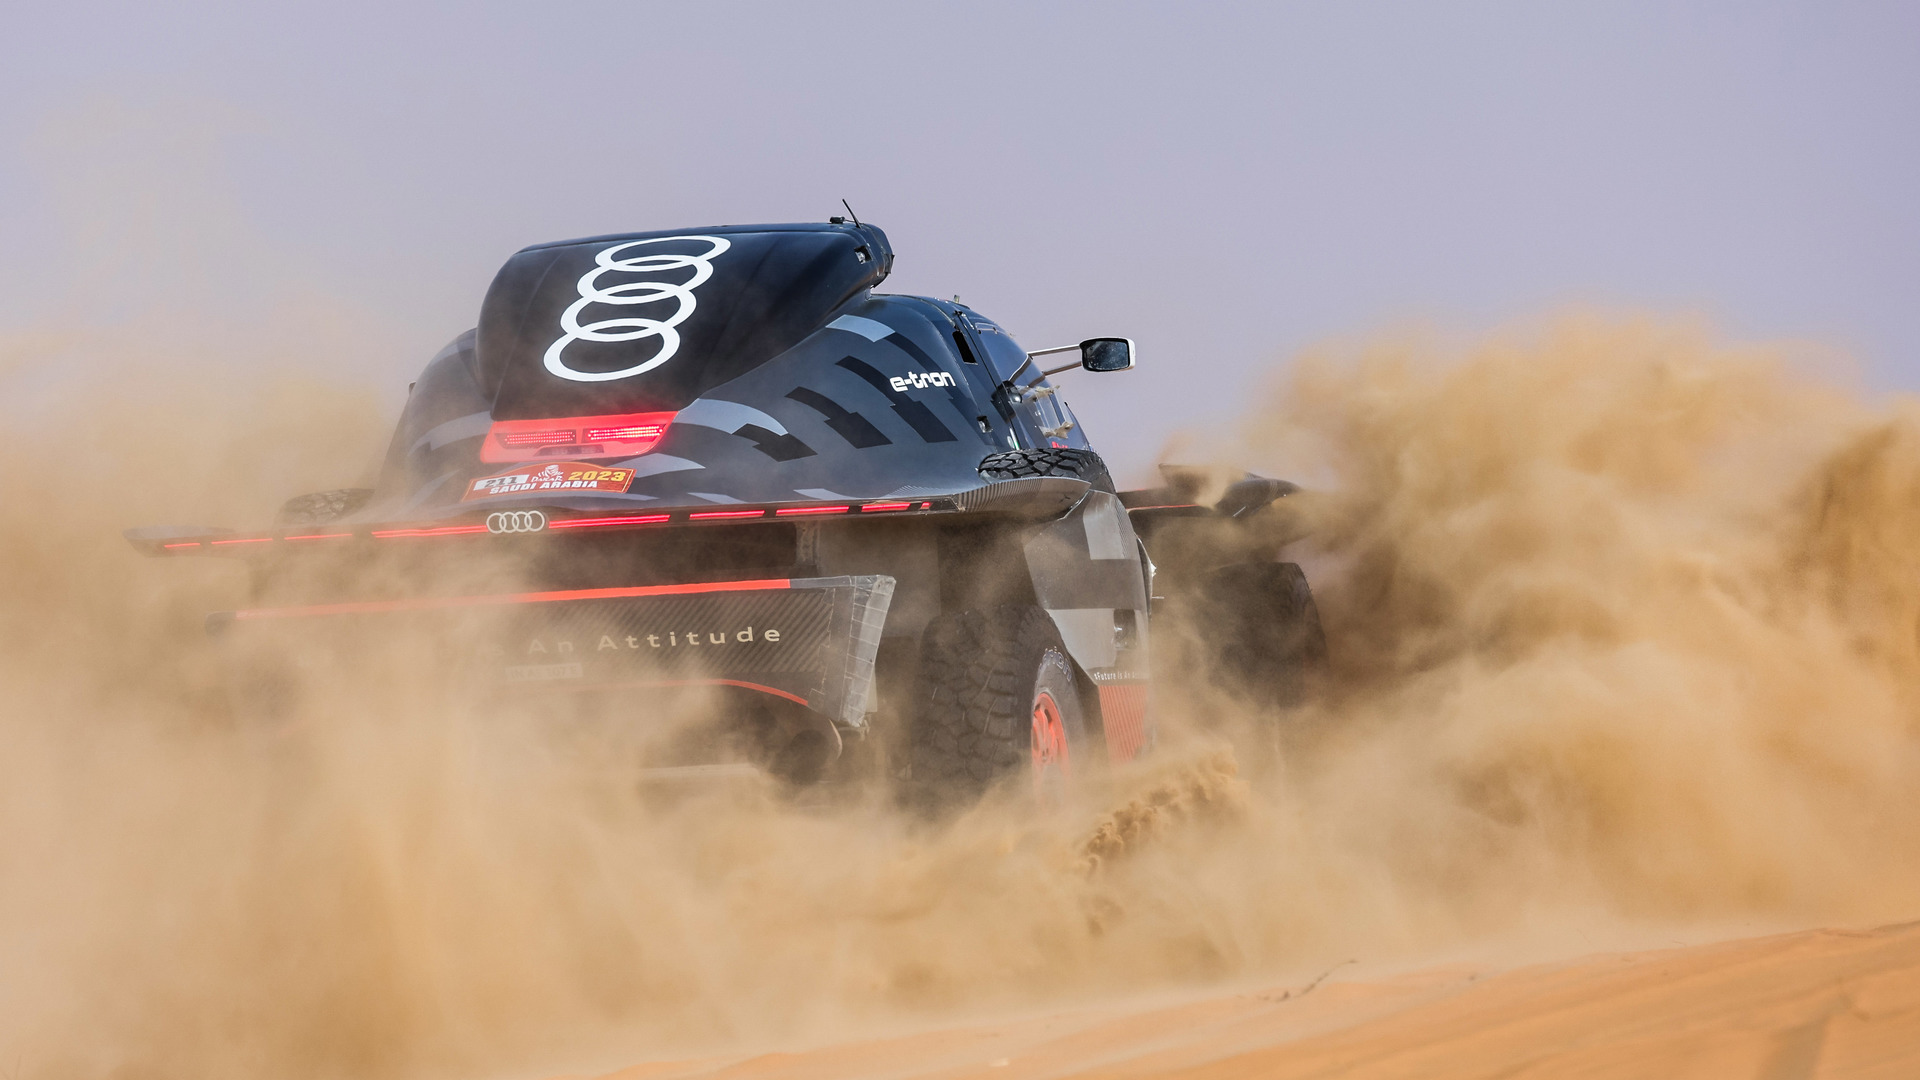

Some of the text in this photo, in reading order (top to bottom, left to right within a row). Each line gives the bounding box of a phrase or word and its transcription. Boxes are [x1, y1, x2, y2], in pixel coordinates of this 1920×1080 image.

[889, 371, 957, 392] e-tron
[484, 476, 518, 488] 211
[567, 470, 626, 482] 2023
[489, 480, 598, 495] SAUDI ARABIA
[528, 638, 574, 654] An
[597, 626, 781, 651] Attitude
